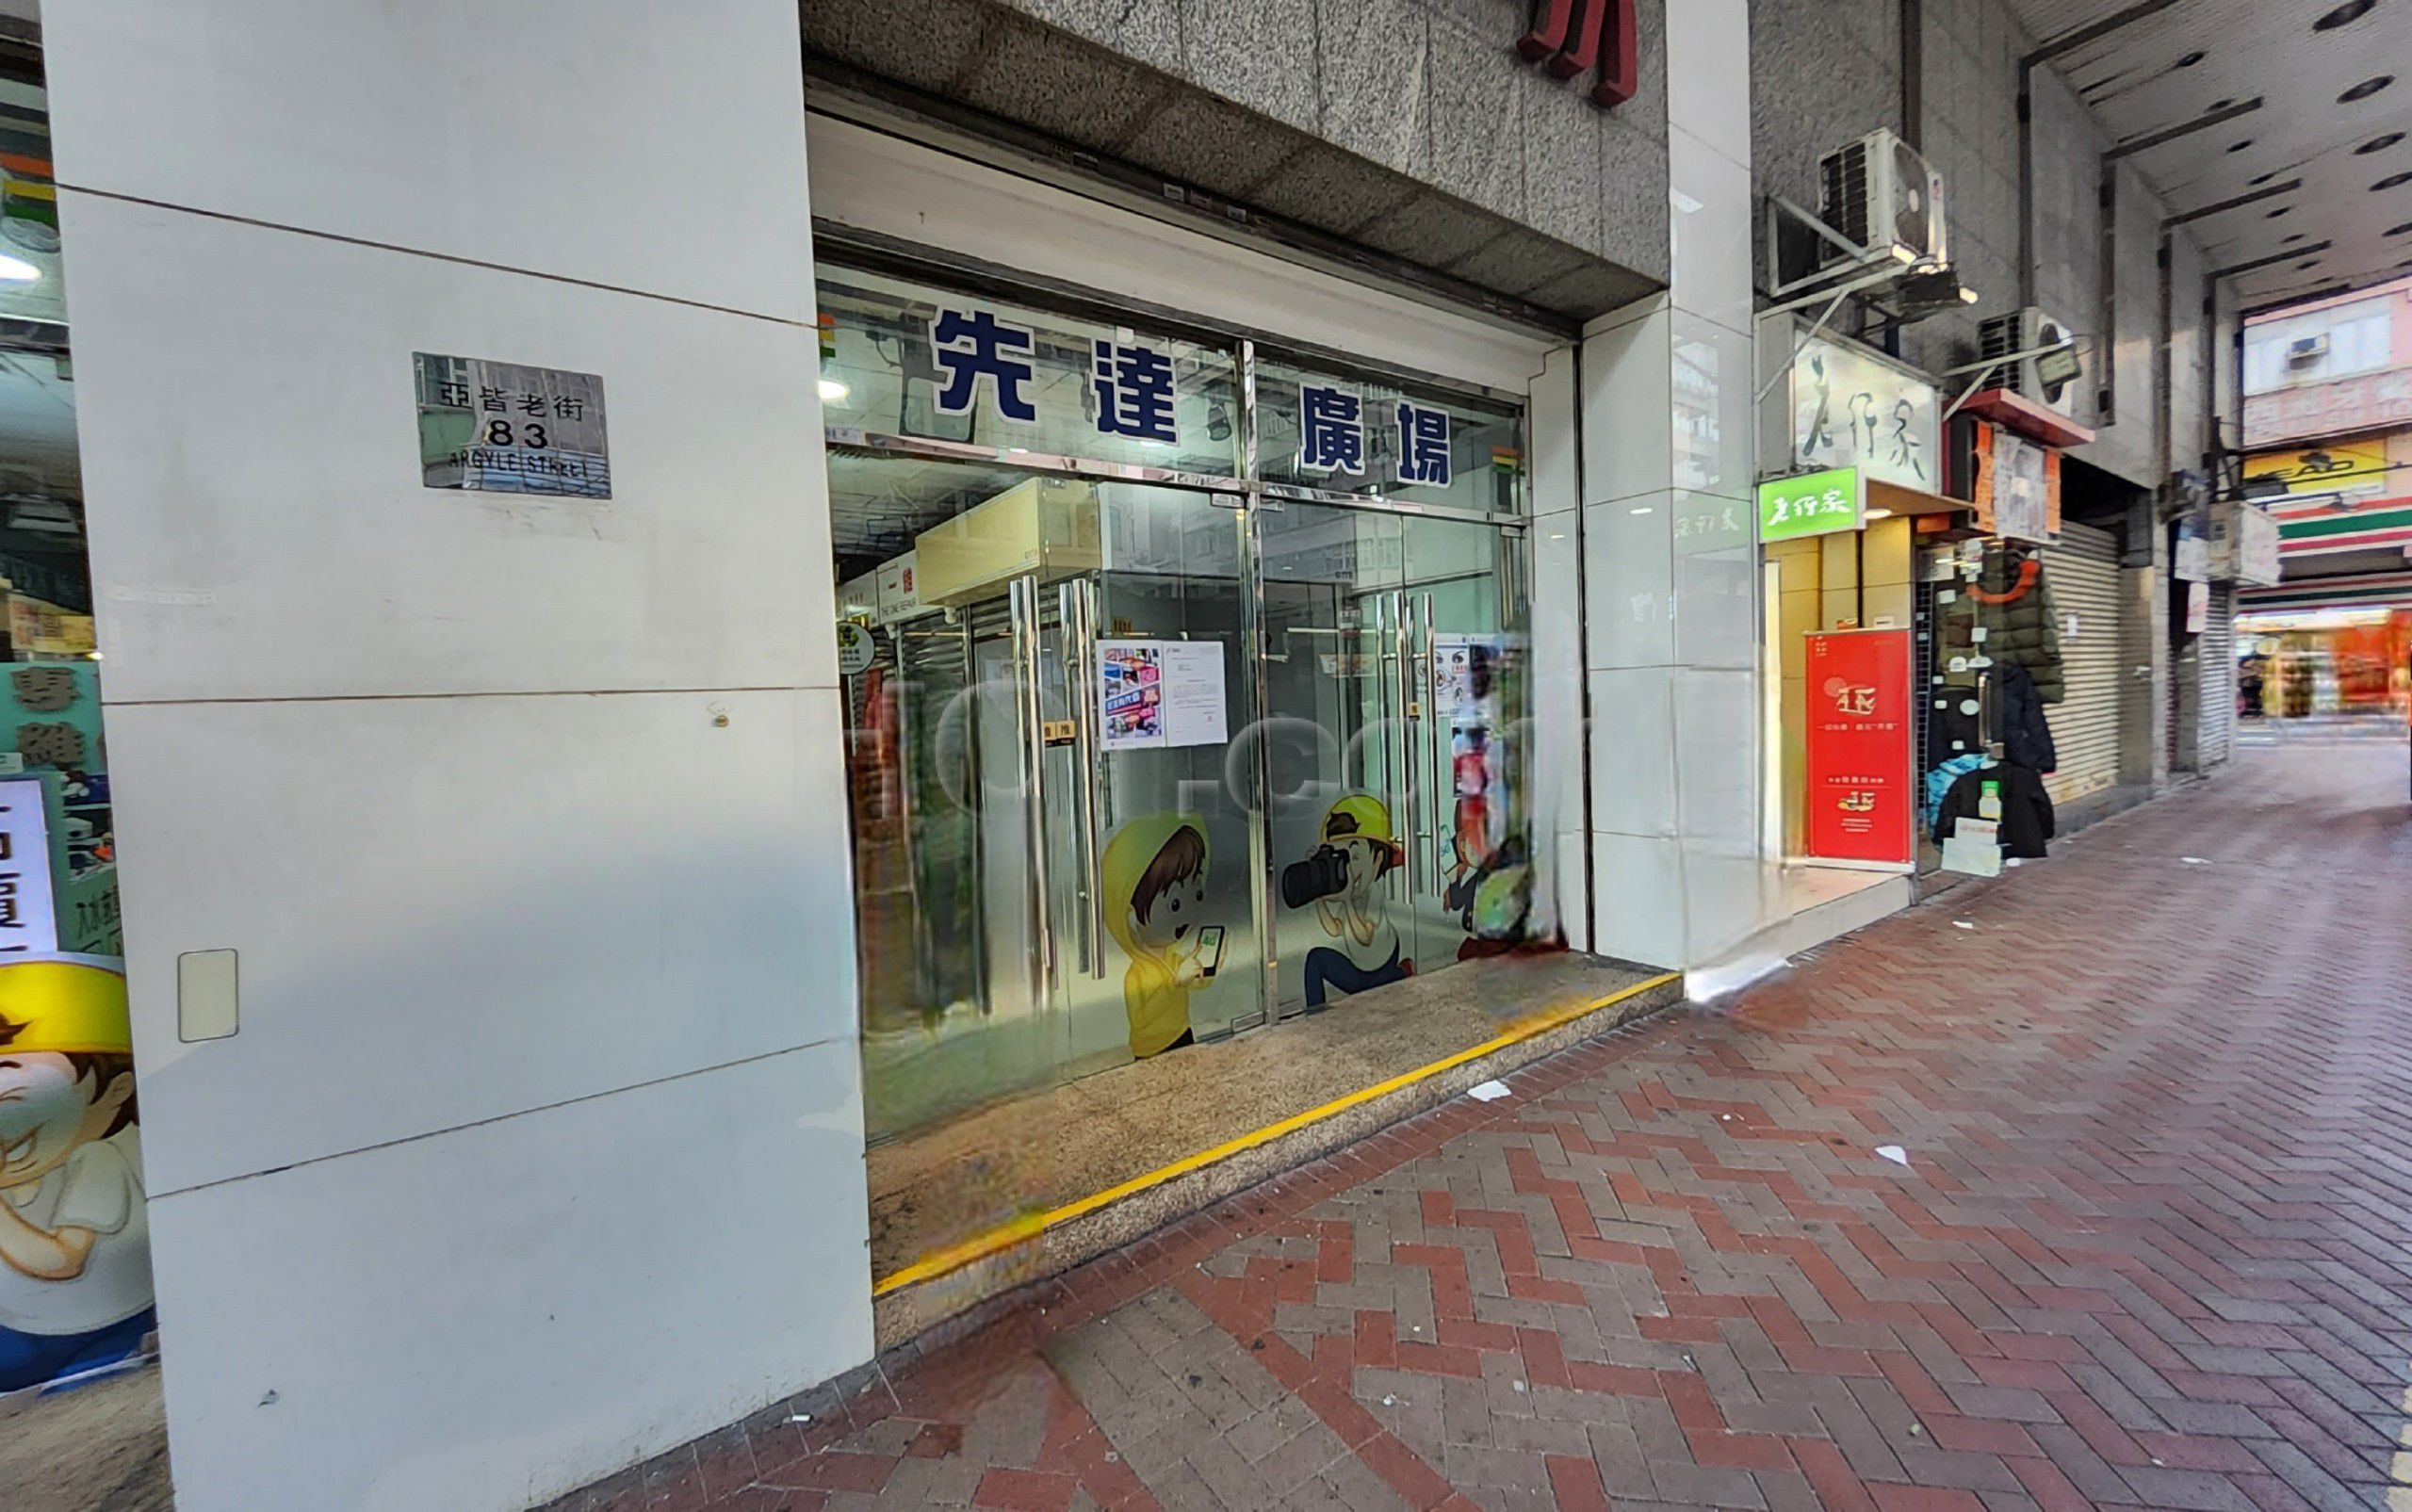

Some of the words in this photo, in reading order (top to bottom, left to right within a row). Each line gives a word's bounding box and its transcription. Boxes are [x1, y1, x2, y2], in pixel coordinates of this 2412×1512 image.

[439, 381, 584, 423] 亞皆老街
[932, 306, 1450, 486] 先達廣場
[488, 419, 549, 450] 83
[448, 450, 518, 472] ARGYLE
